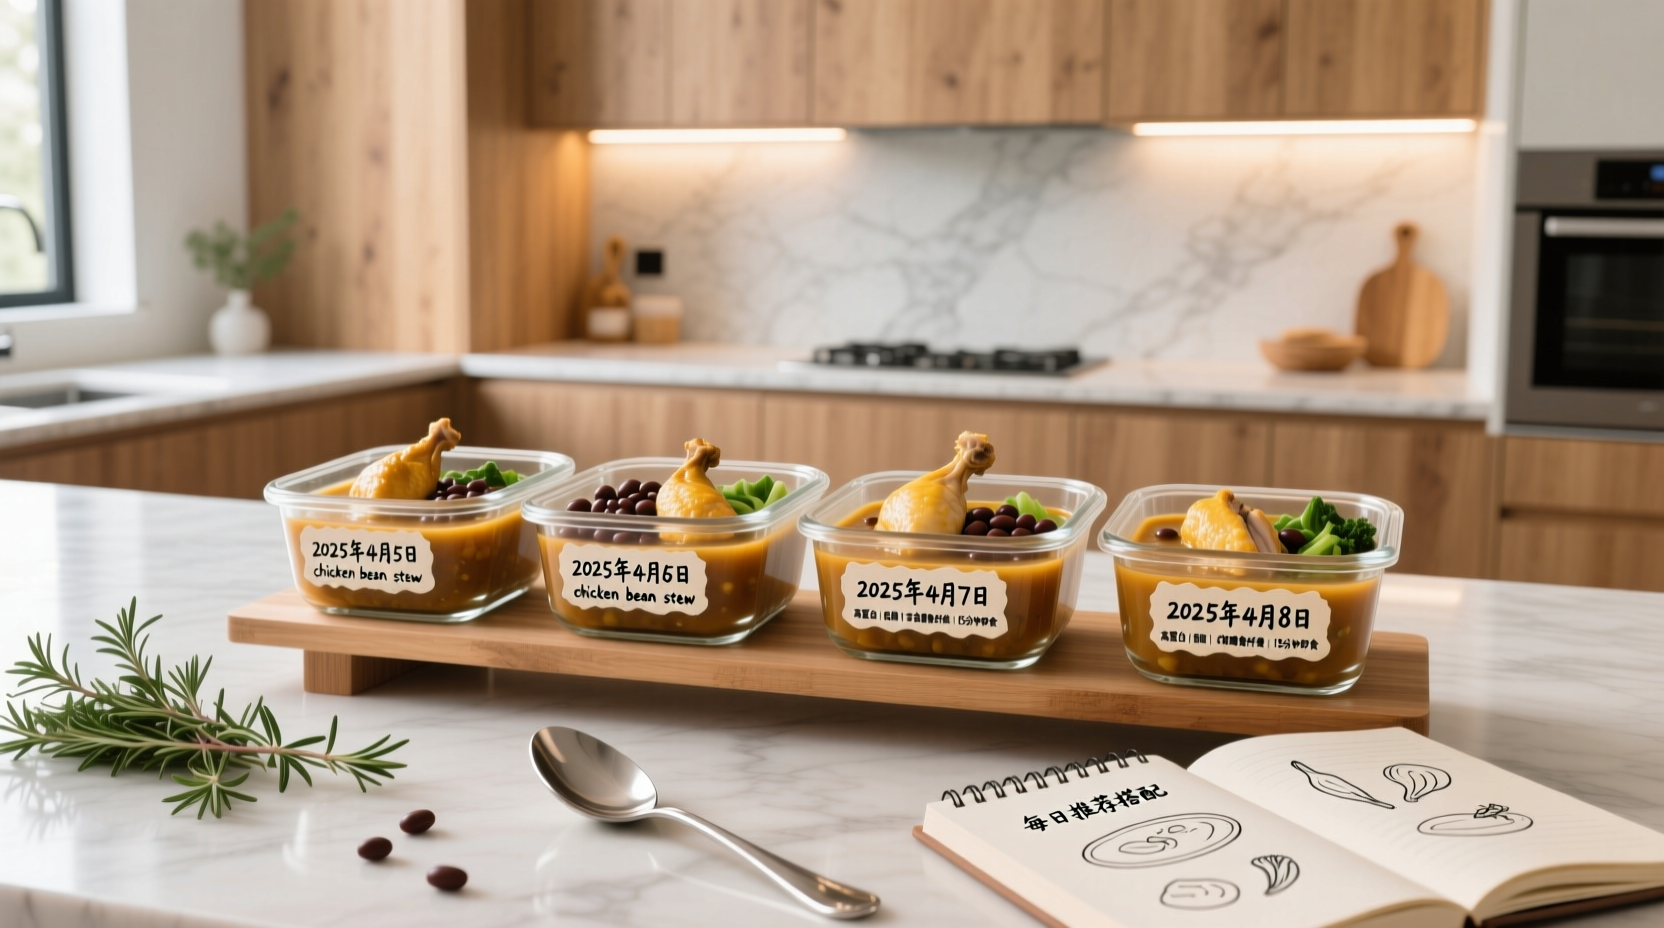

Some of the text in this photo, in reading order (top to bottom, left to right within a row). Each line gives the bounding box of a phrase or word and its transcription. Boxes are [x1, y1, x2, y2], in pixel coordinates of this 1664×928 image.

[312, 539, 417, 565] 2025年4月5日
[313, 563, 423, 583] chicken bean stew
[573, 584, 696, 605] chicken bean stew
[856, 578, 988, 607] 2025年4月7日
[1166, 600, 1310, 631] 2025年4月8日
[1023, 783, 1169, 832] 每日推荐搭配
